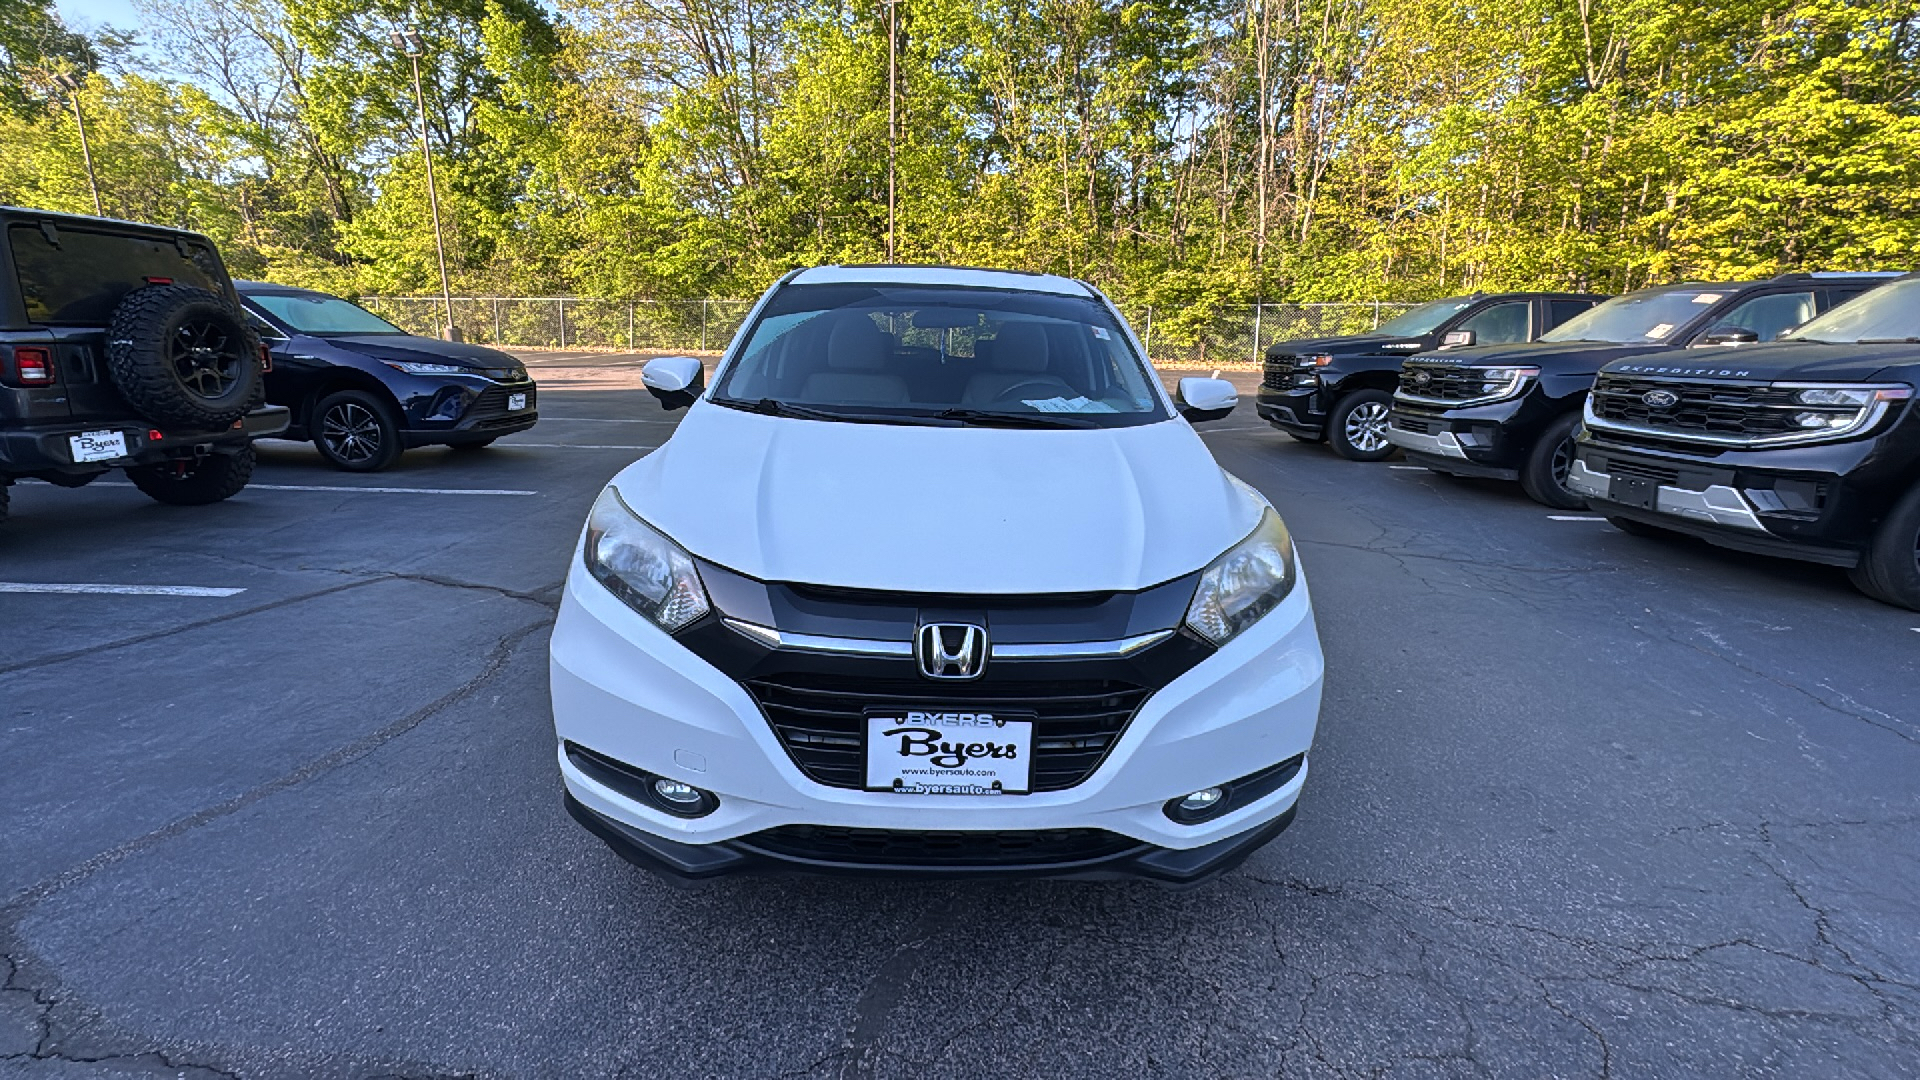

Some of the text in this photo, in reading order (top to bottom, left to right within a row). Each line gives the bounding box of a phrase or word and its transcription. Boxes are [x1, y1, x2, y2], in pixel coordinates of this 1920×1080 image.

[1620, 365, 1750, 377] EXPEDITION
[73, 437, 120, 451] Byers
[907, 711, 994, 728] BYERS
[882, 727, 1017, 768] Byers
[901, 767, 996, 777] www.byersauto.com
[893, 782, 1002, 796] www.byersauto.com
